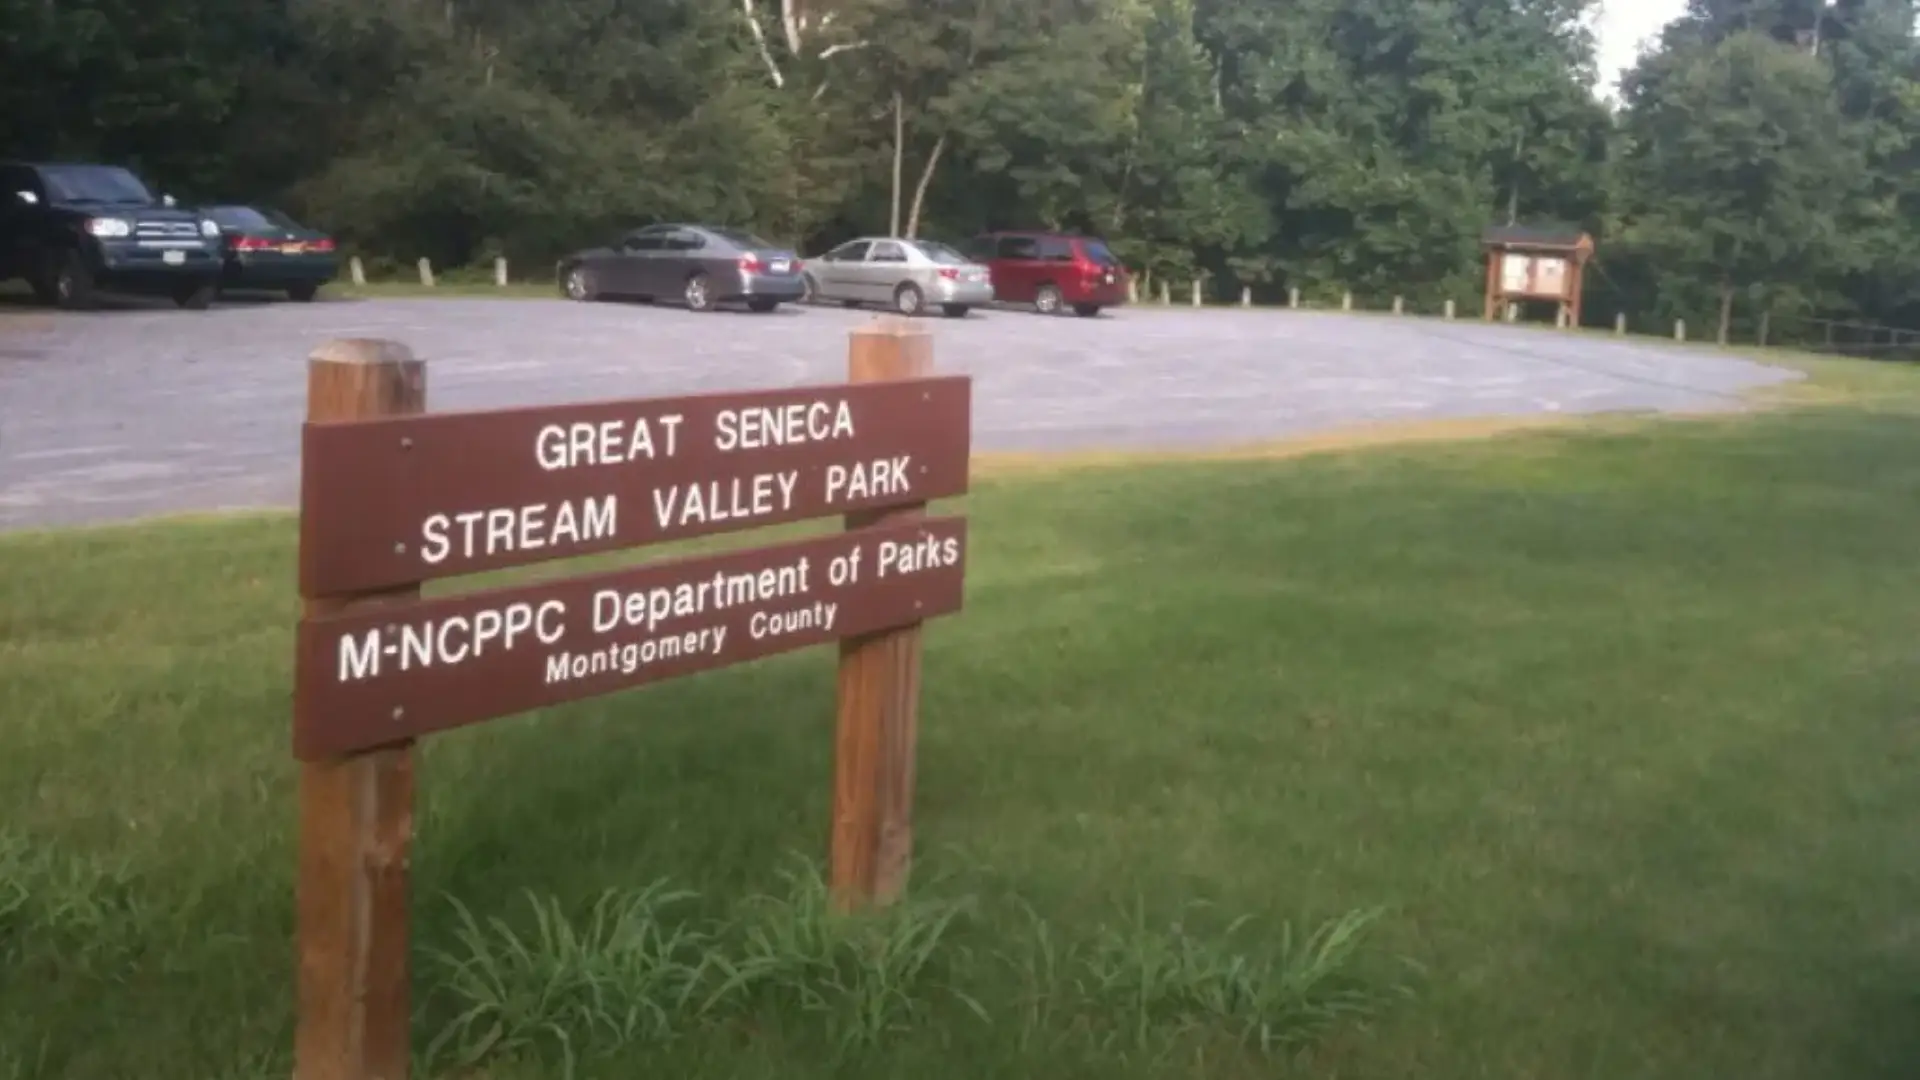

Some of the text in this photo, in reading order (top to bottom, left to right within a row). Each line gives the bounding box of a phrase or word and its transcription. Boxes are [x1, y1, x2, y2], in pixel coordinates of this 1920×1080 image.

[535, 399, 855, 471] GREAT SENECA
[420, 455, 912, 563] STREAM VALLEY PARK
[337, 532, 959, 682] M-NCPPC Department of Parks
[545, 602, 838, 684] Montgomery County
